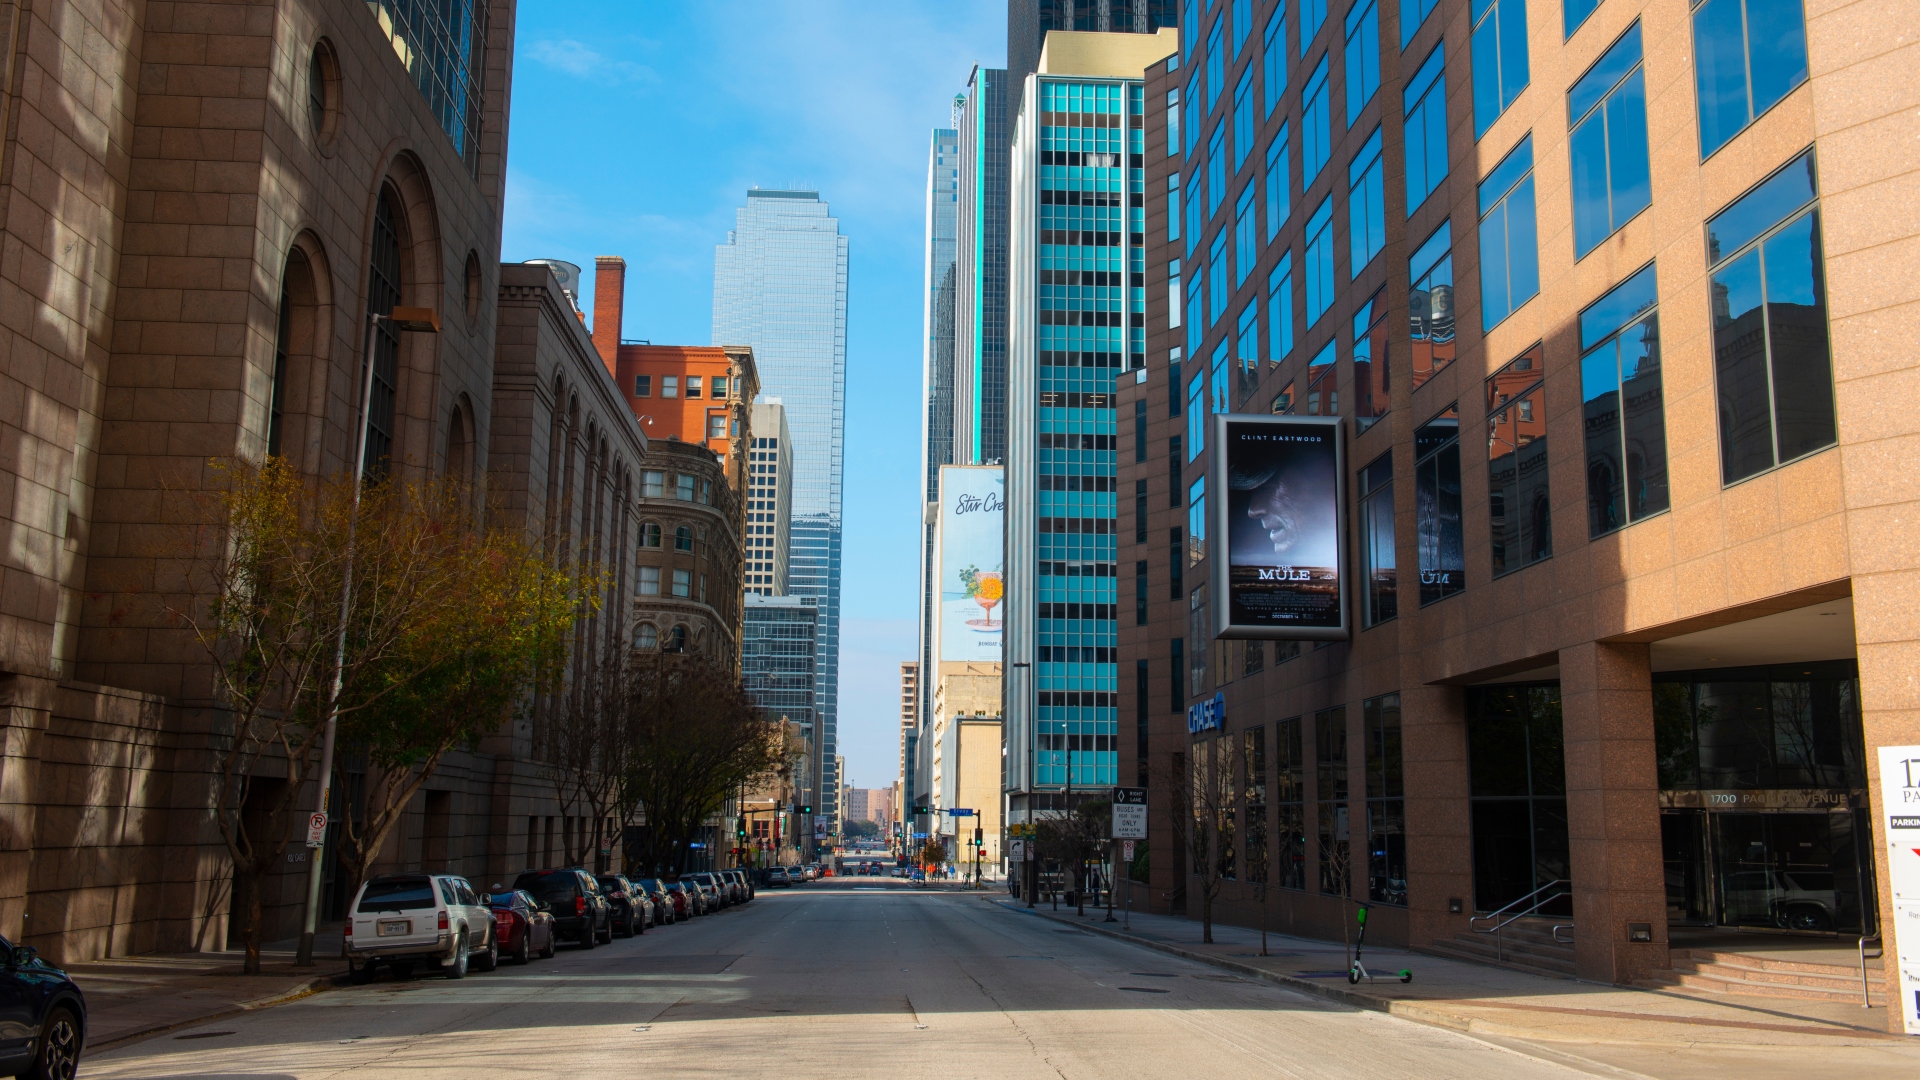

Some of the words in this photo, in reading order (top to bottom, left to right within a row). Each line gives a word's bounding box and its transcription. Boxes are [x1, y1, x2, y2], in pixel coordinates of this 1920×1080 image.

[956, 493, 983, 515] Stir
[1258, 568, 1310, 581] MULE
[1188, 698, 1215, 734] CHASE
[1710, 794, 1737, 804] 1700
[1743, 794, 1788, 804] PACIFIC
[1795, 794, 1847, 804] AVENUE
